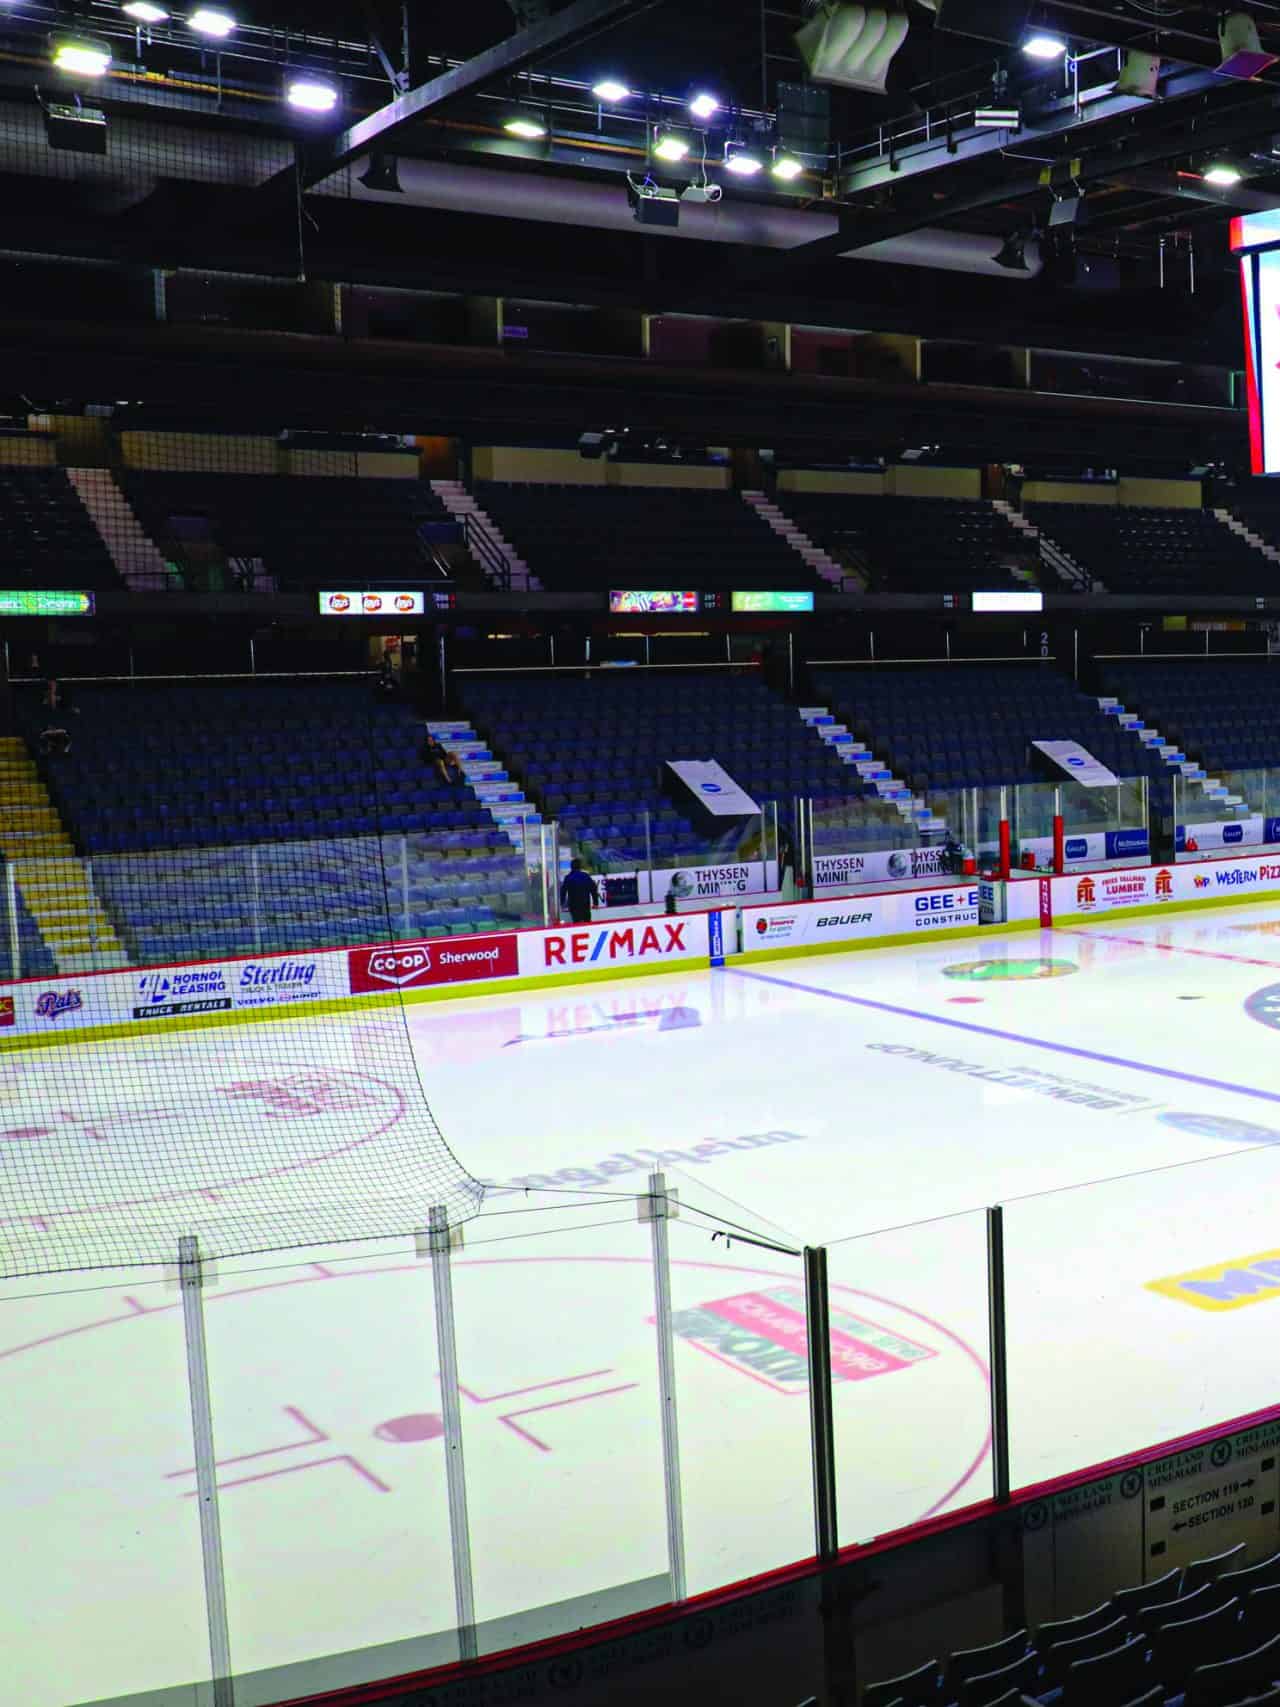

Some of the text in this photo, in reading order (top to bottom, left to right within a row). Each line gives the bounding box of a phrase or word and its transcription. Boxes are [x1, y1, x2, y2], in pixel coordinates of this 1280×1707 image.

[814, 857, 865, 872] THYSSEN
[694, 867, 749, 884] THYSSEN
[1215, 866, 1258, 887] WESTERN
[1106, 883, 1144, 895] LUMBER
[915, 894, 954, 911] GEE
[817, 912, 873, 927] BAUER
[544, 922, 686, 966] RE/MAX
[374, 954, 424, 971] CO-OP
[440, 946, 500, 964] Sherwood
[173, 970, 223, 985] HORNOI
[240, 961, 317, 987] Sterling
[172, 981, 226, 996] LEASING
[138, 1000, 228, 1017] TRUCK RENTALS
[1173, 1482, 1239, 1514] SECTION 119
[1188, 1503, 1234, 1528] SECTION
